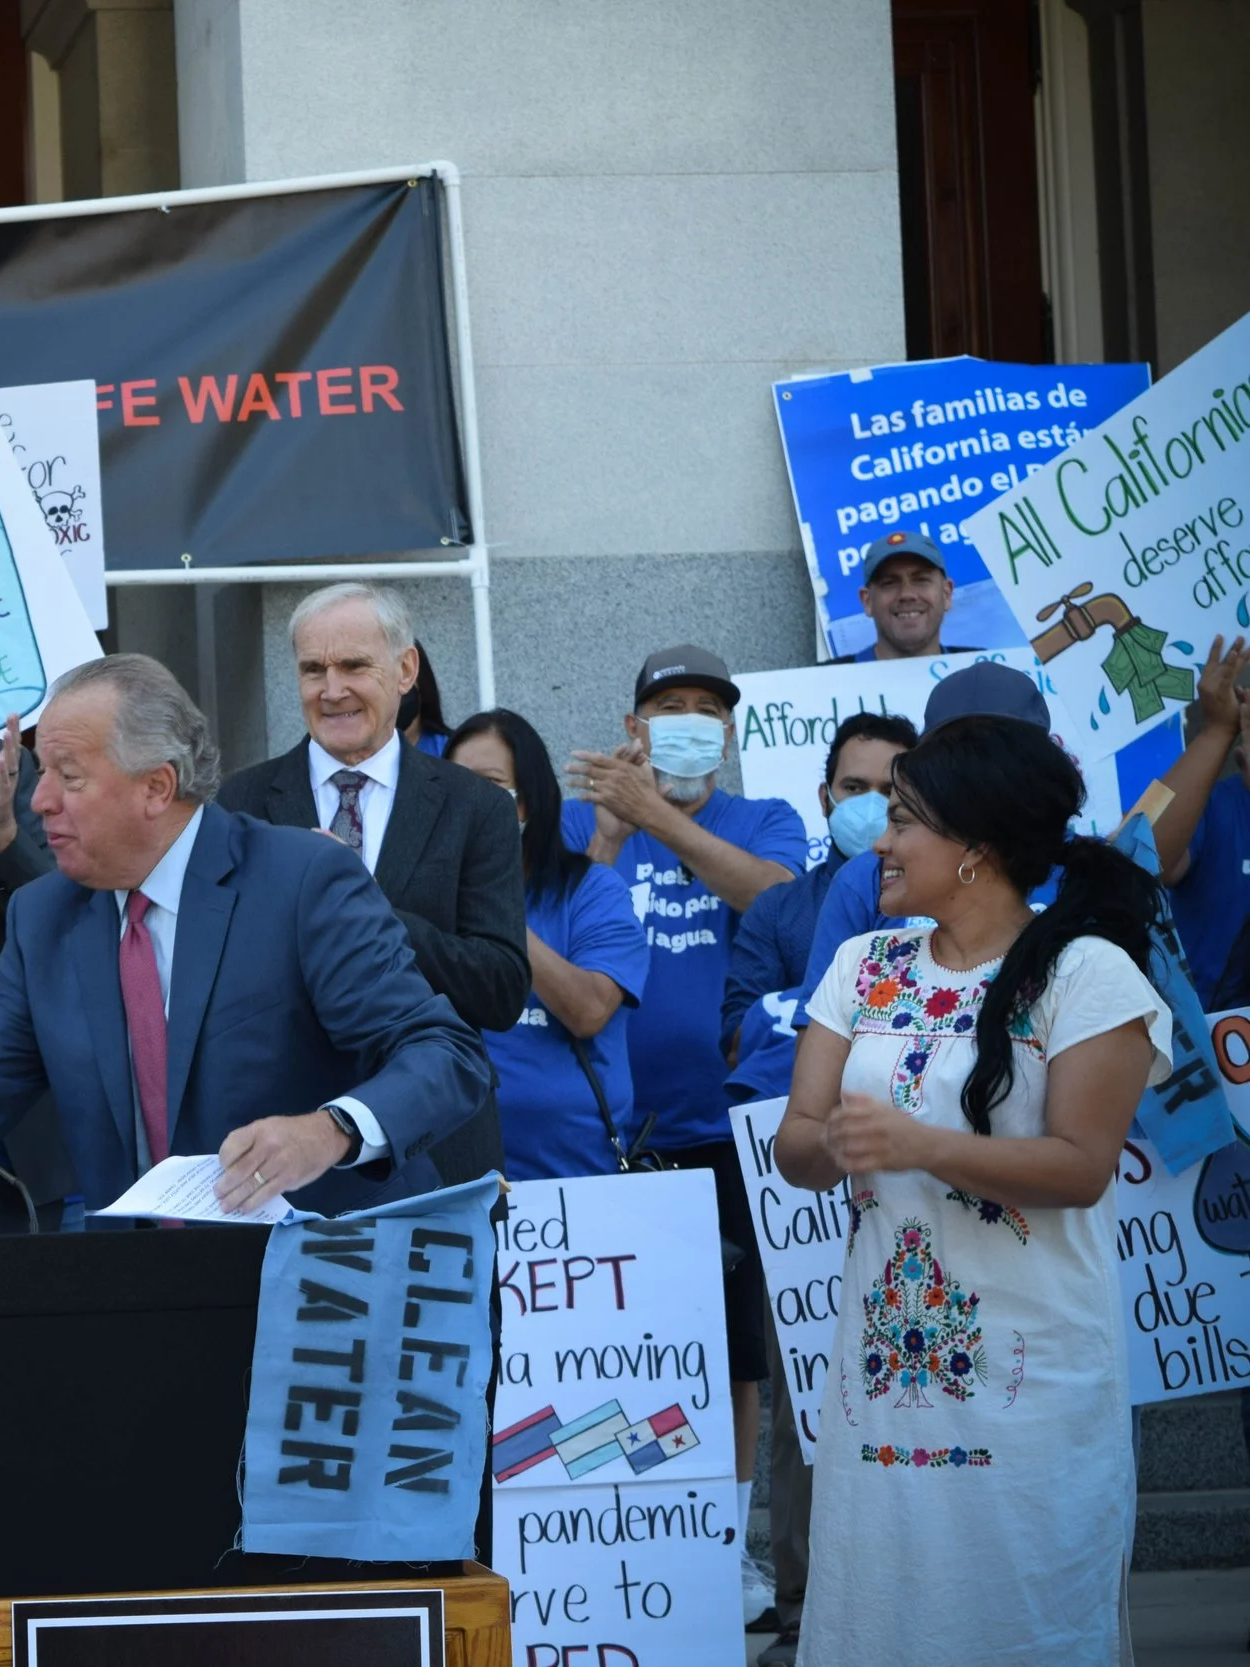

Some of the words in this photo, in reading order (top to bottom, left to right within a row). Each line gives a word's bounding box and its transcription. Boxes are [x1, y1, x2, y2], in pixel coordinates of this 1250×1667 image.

[178, 365, 405, 424] WATER
[850, 405, 907, 440] Las
[910, 386, 1041, 429] familias
[1047, 382, 1088, 408] de
[22, 455, 67, 490] or
[850, 428, 1011, 481] California
[835, 474, 983, 535] pagando
[997, 496, 1063, 586] All
[1122, 496, 1244, 588] deserve
[685, 894, 722, 919] por
[655, 928, 718, 954] agua
[1134, 1263, 1221, 1333] due
[277, 1219, 377, 1492] WATER
[384, 1227, 475, 1494] CLEAN
[555, 1332, 710, 1410] moving
[1154, 1324, 1250, 1391] bills
[518, 1484, 736, 1575] pandemic,
[614, 1560, 672, 1620] to
